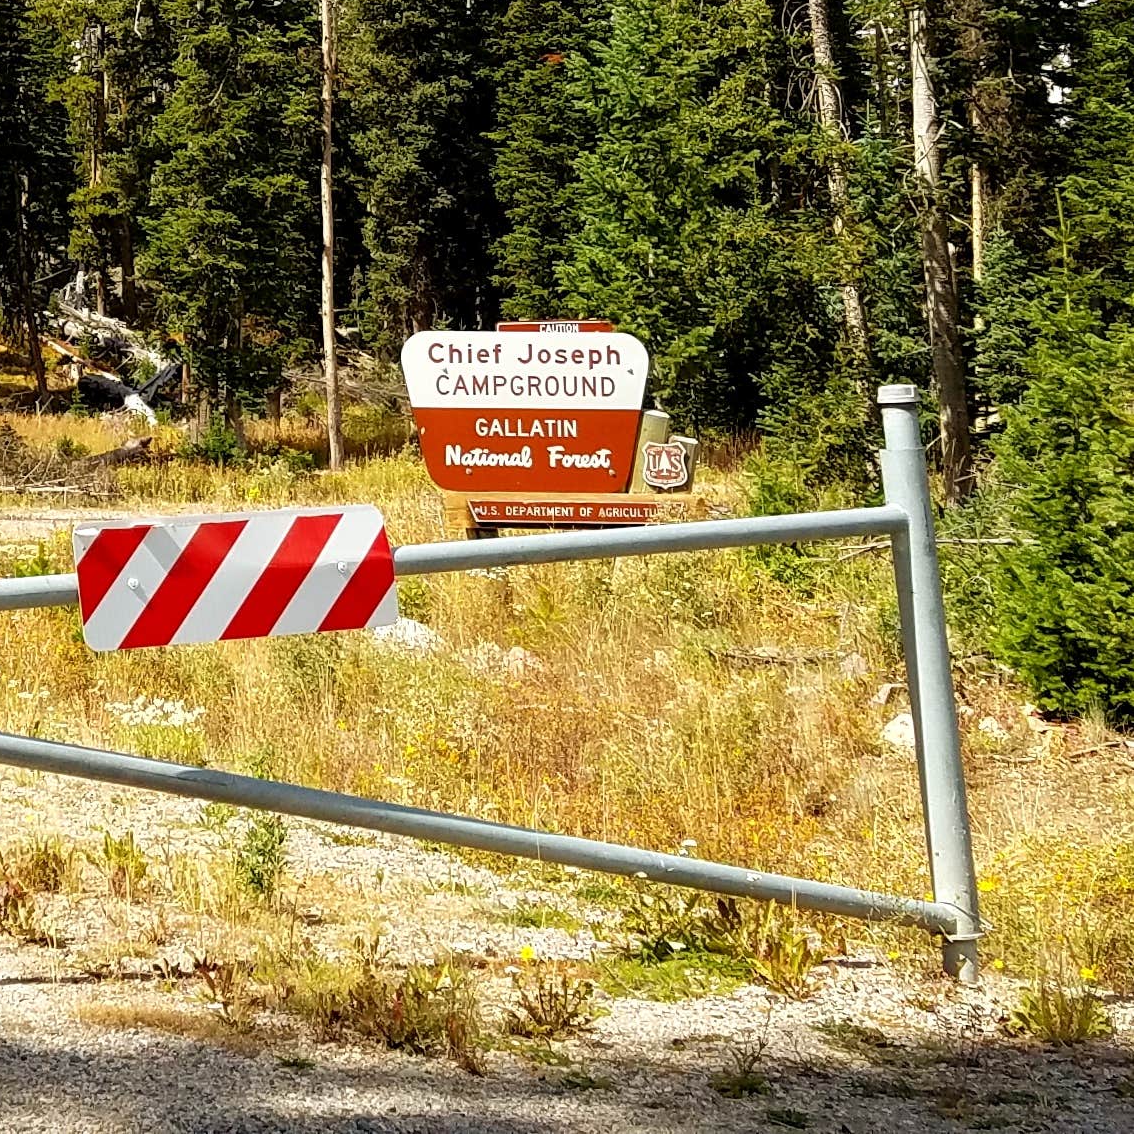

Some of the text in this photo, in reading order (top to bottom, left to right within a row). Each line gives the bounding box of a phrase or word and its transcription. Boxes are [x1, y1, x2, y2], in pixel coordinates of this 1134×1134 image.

[540, 324, 579, 332] CAUTION
[428, 343, 621, 369] Chief Joseph
[436, 374, 616, 397] CAMPGROUND
[475, 419, 577, 437] GALLATIN
[445, 445, 611, 468] National Forest
[479, 506, 500, 516] U.S.
[506, 506, 574, 517] DEPARTMENT
[579, 507, 593, 517] OF
